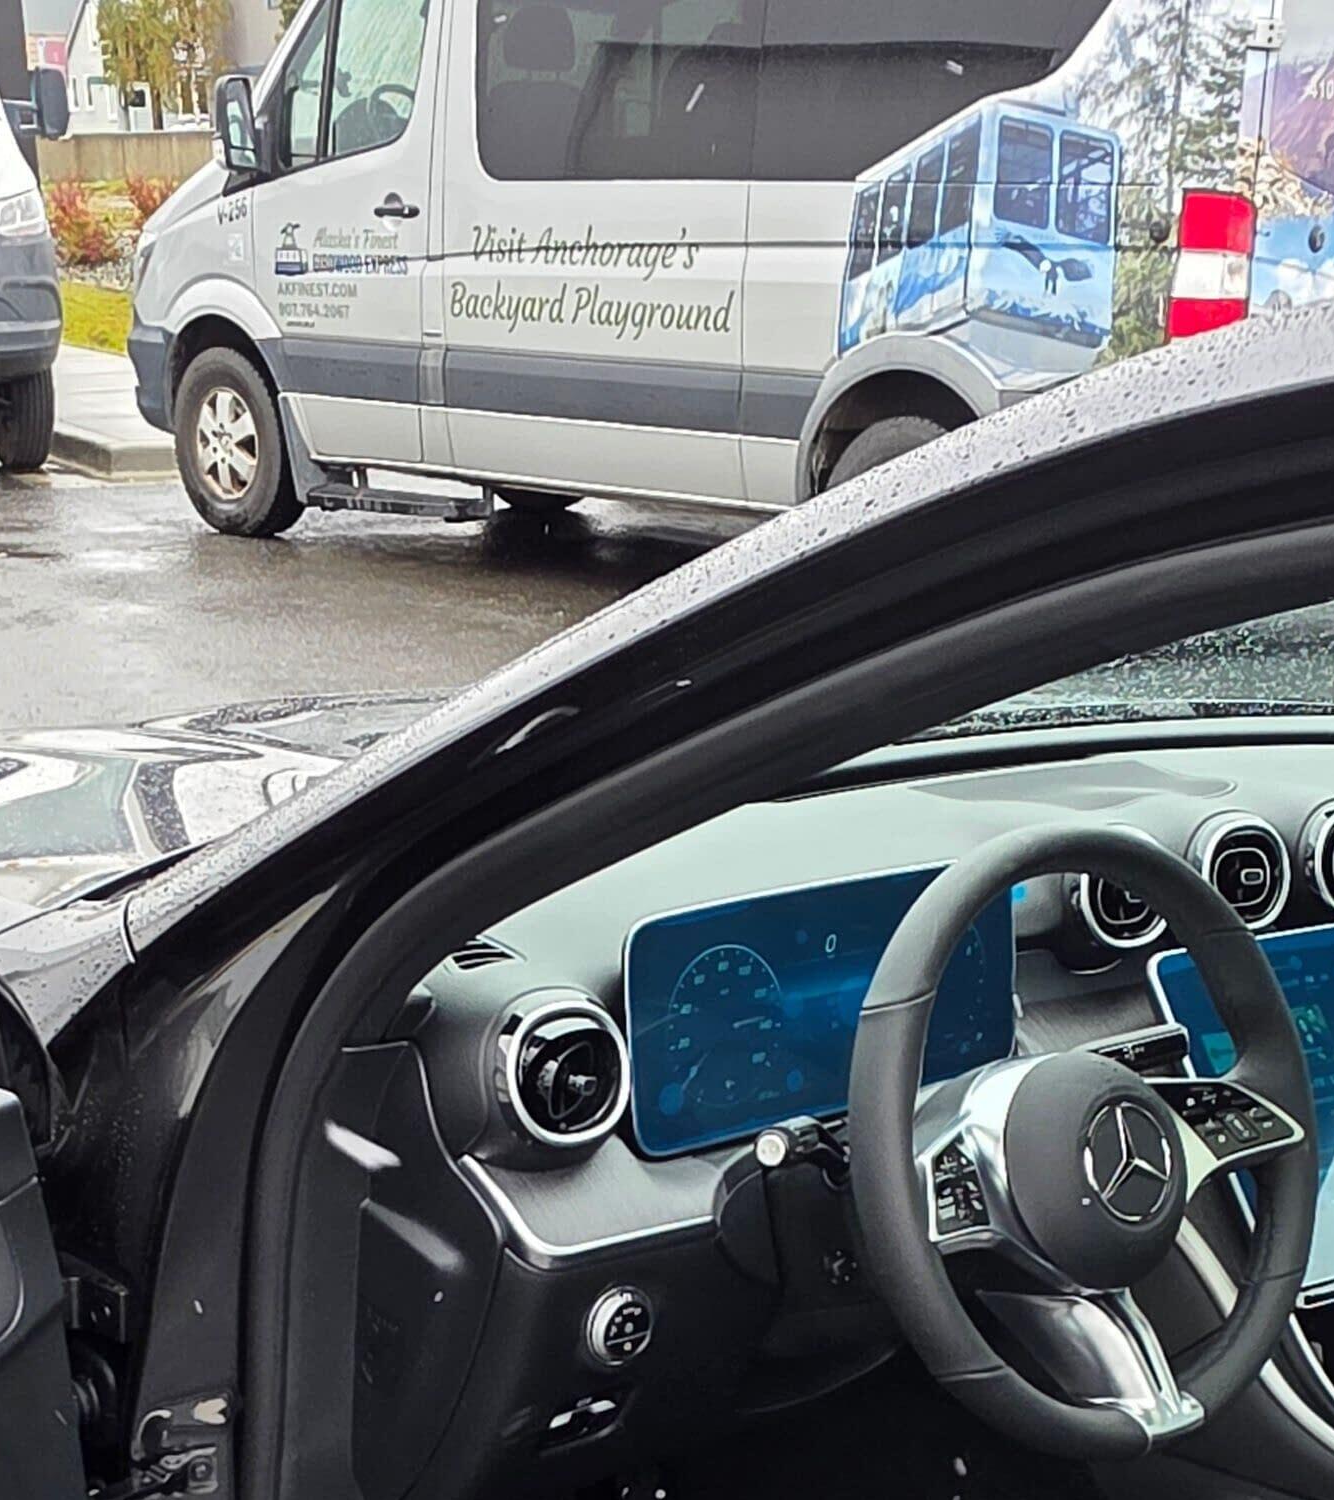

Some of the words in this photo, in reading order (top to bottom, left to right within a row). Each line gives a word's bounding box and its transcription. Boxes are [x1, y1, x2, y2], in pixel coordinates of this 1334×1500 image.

[471, 223, 528, 264] Visit
[530, 224, 701, 282] Anchorage's
[450, 279, 568, 334] Backyard
[571, 283, 735, 341] Playground
[824, 933, 837, 953] 0
